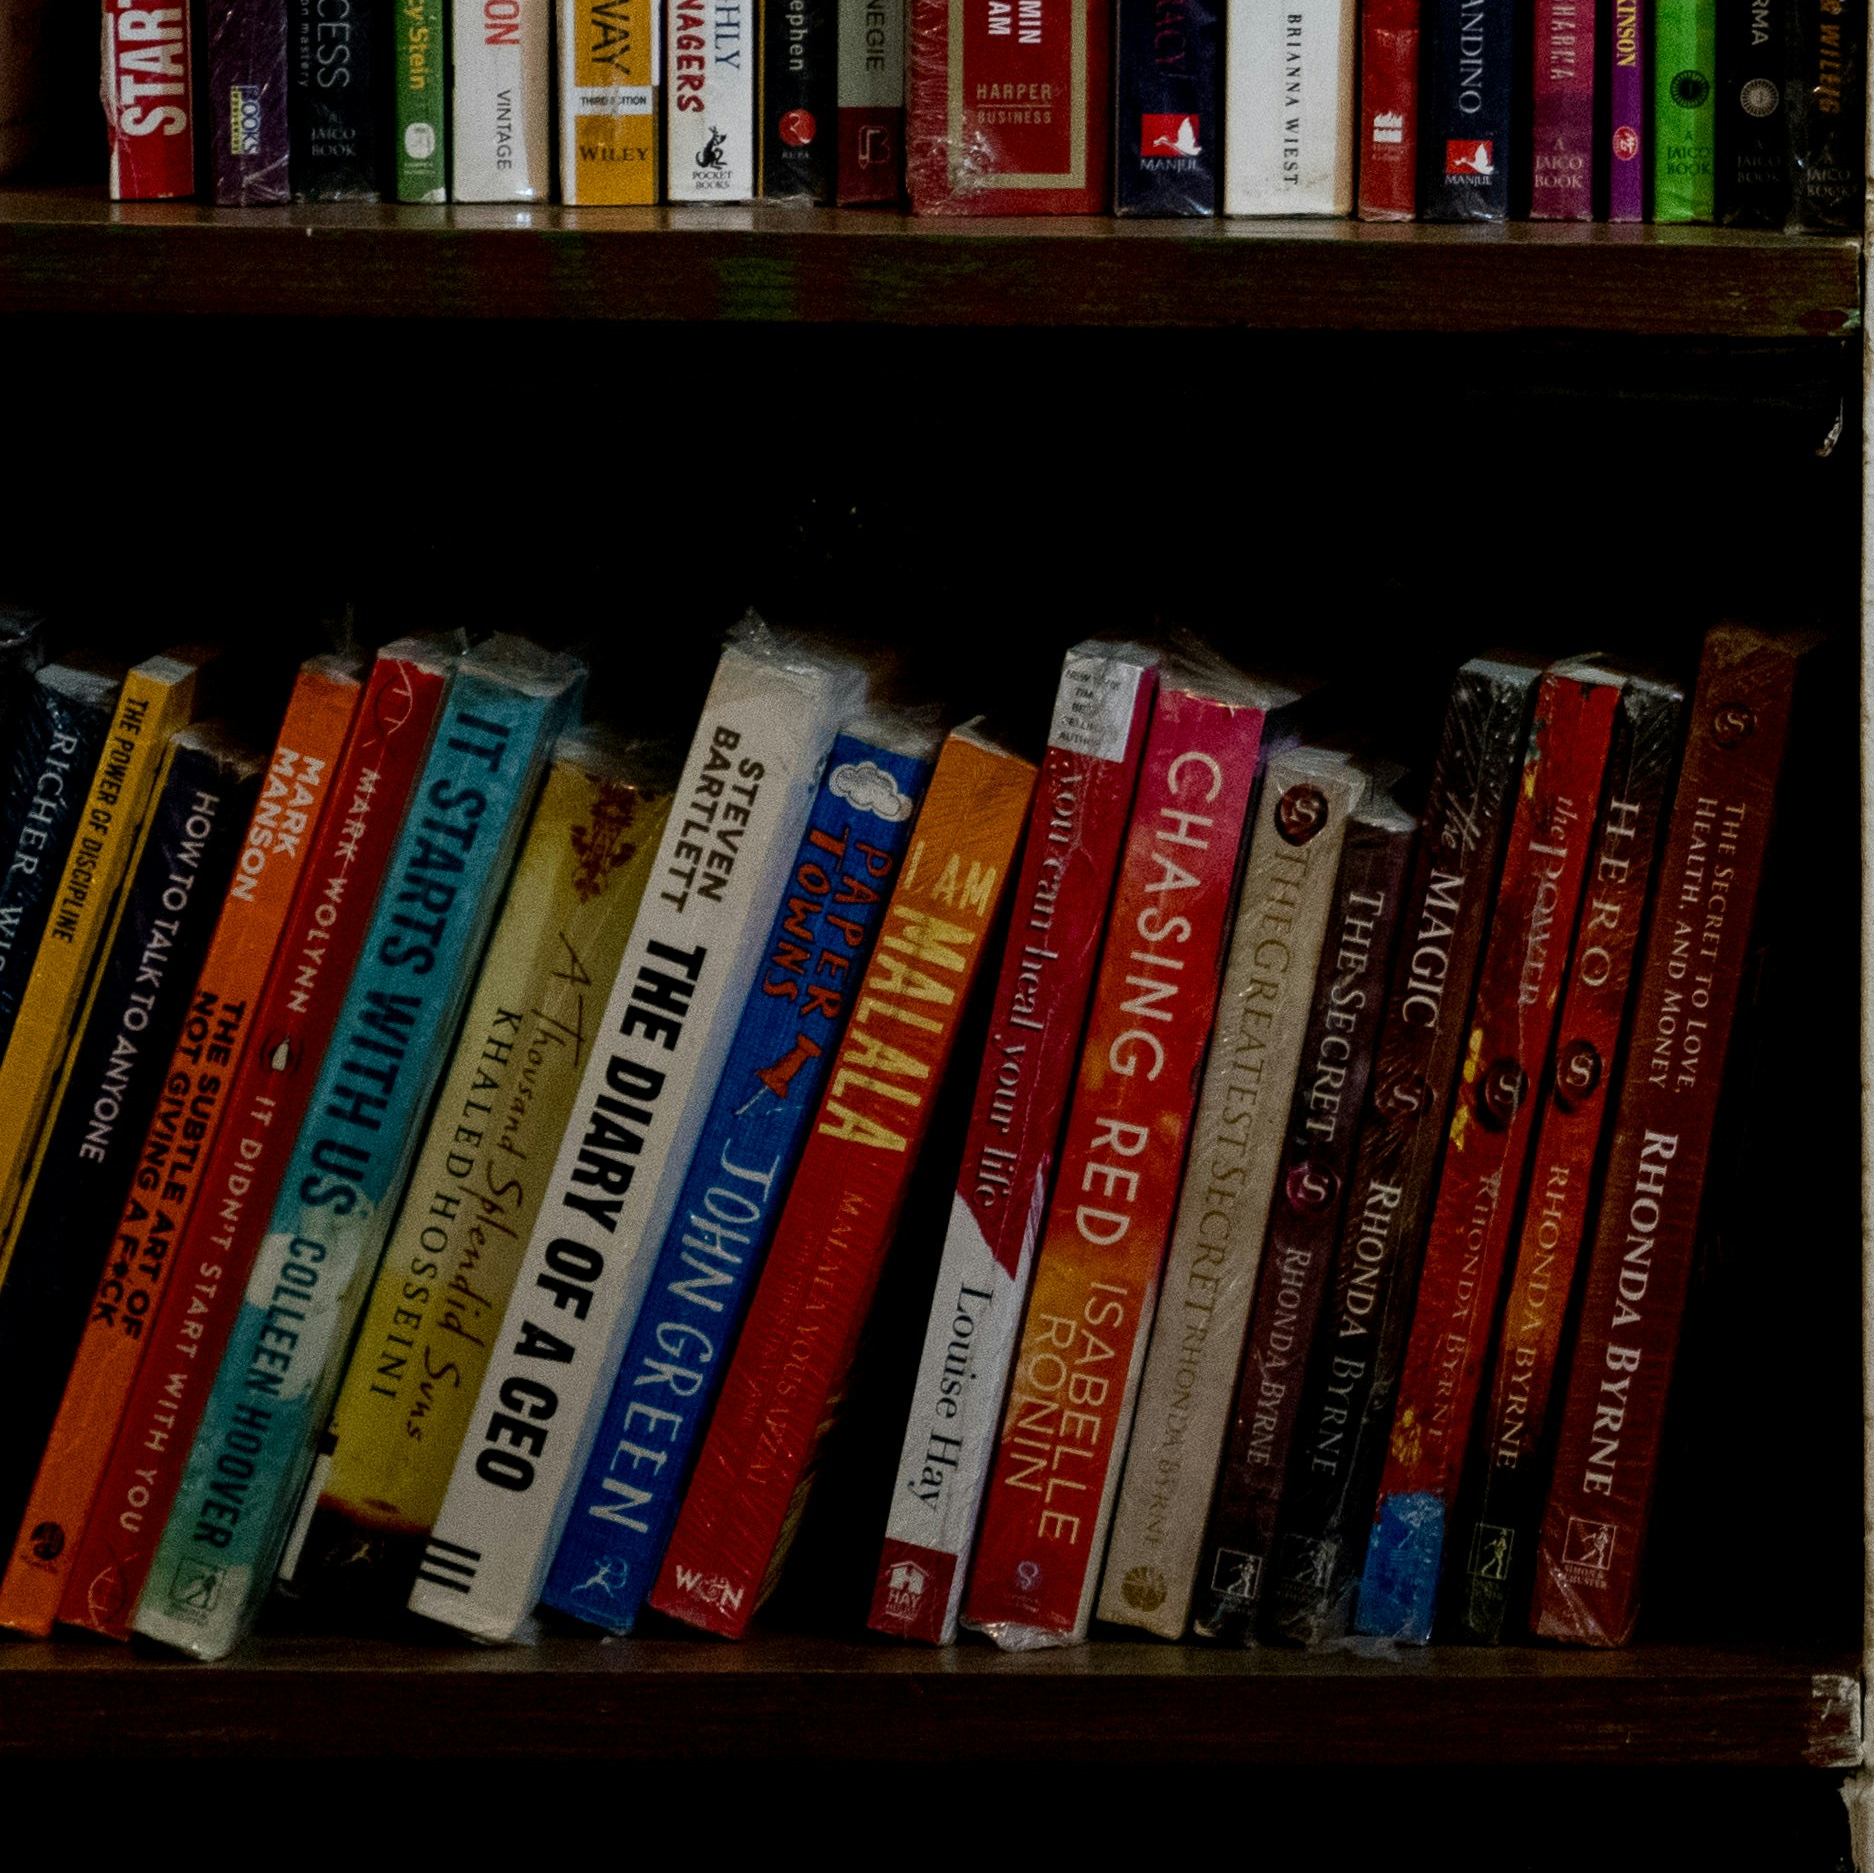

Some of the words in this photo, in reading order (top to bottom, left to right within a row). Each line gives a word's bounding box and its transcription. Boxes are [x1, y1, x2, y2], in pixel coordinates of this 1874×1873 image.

[1285, 15, 1302, 108] BRIANNA
[496, 90, 512, 170] VINTAGE
[1283, 120, 1299, 186] WIEST
[271, 755, 326, 859] MARK
[450, 713, 510, 773] IT
[177, 791, 220, 867] HOW
[230, 747, 299, 902] MANSON
[378, 779, 487, 975] STARTS
[660, 726, 740, 914] BARTLETT
[699, 758, 765, 902] STEVEN
[135, 918, 179, 990] TALK
[161, 872, 194, 912] TO
[1108, 751, 1223, 1082] CHASING
[123, 993, 155, 1031] TO
[321, 991, 422, 1130] WITH
[78, 1033, 138, 1161] ANYONE
[299, 1138, 371, 1216] US
[1076, 1117, 1149, 1246] RED
[1611, 1128, 1679, 1331] RHONDA
[253, 1236, 326, 1400] COLLEEN
[935, 1282, 994, 1419] Louise
[907, 1427, 963, 1512] Hay
[1005, 1314, 1078, 1492] RONIN
[1038, 1281, 1129, 1544] ISABELLE
[1582, 1343, 1642, 1497] BYRNE
[193, 1404, 273, 1551] HOOVER
